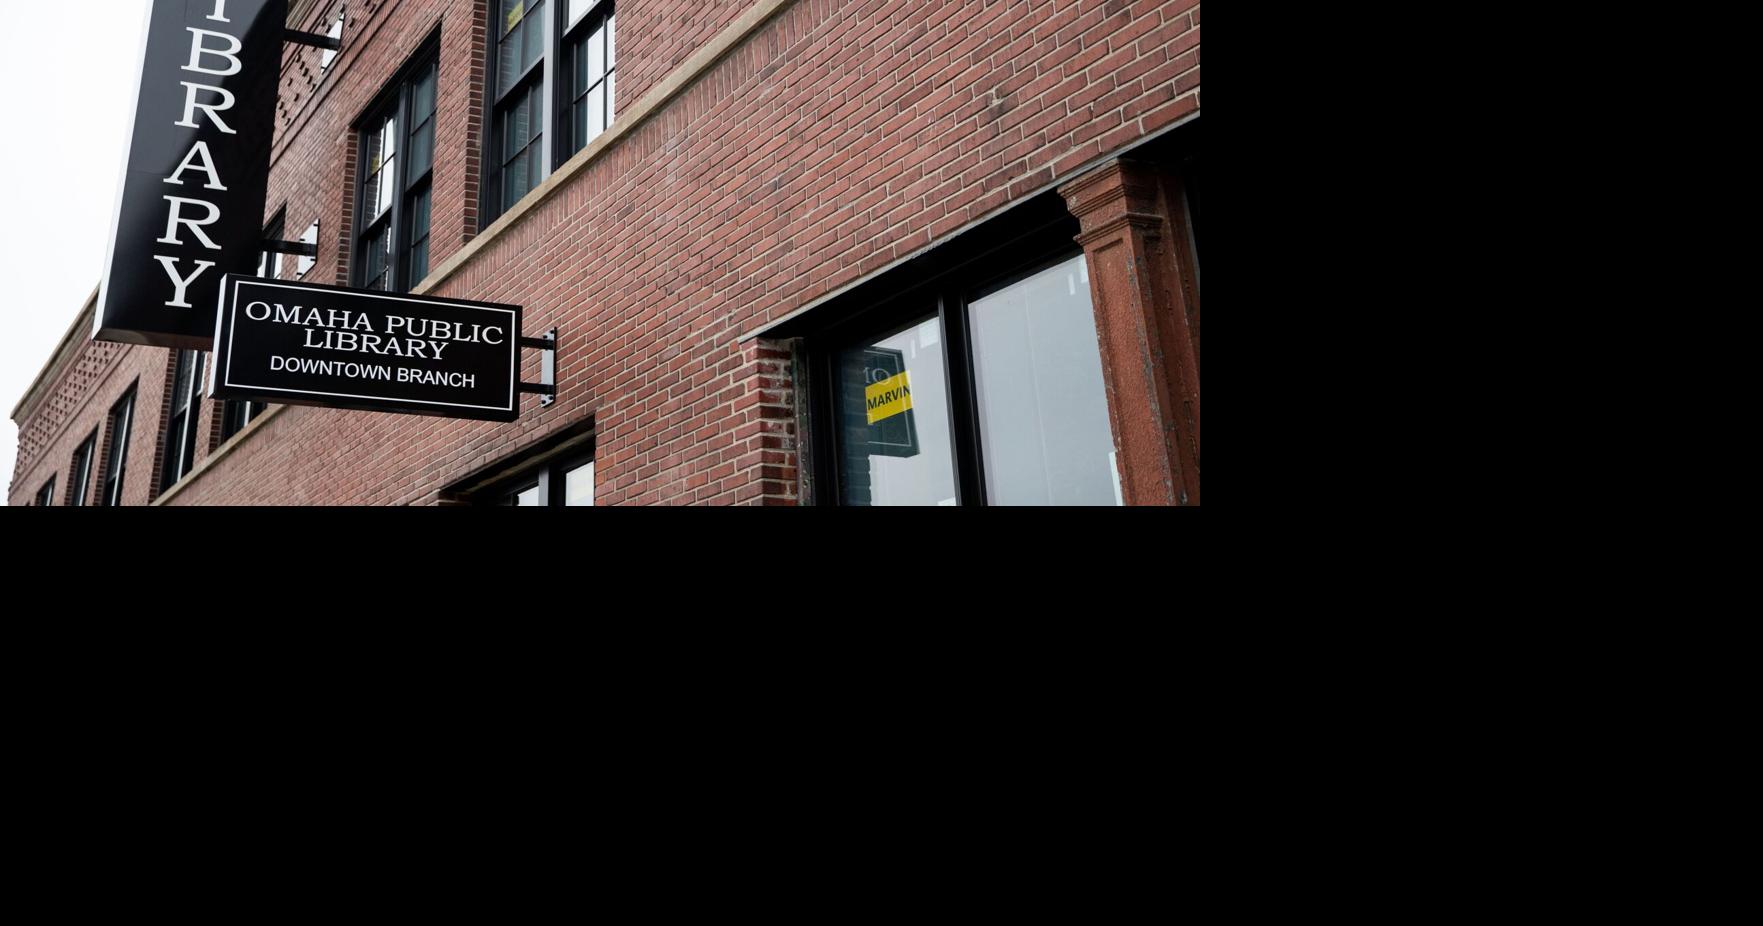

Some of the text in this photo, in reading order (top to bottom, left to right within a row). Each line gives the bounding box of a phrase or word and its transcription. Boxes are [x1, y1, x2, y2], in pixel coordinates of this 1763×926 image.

[245, 301, 504, 345] OMAHA PUBLIC
[303, 328, 449, 360] LIBRARY
[270, 355, 475, 389] DOWNTOWN BRANCH
[867, 385, 911, 410] MARVIN
